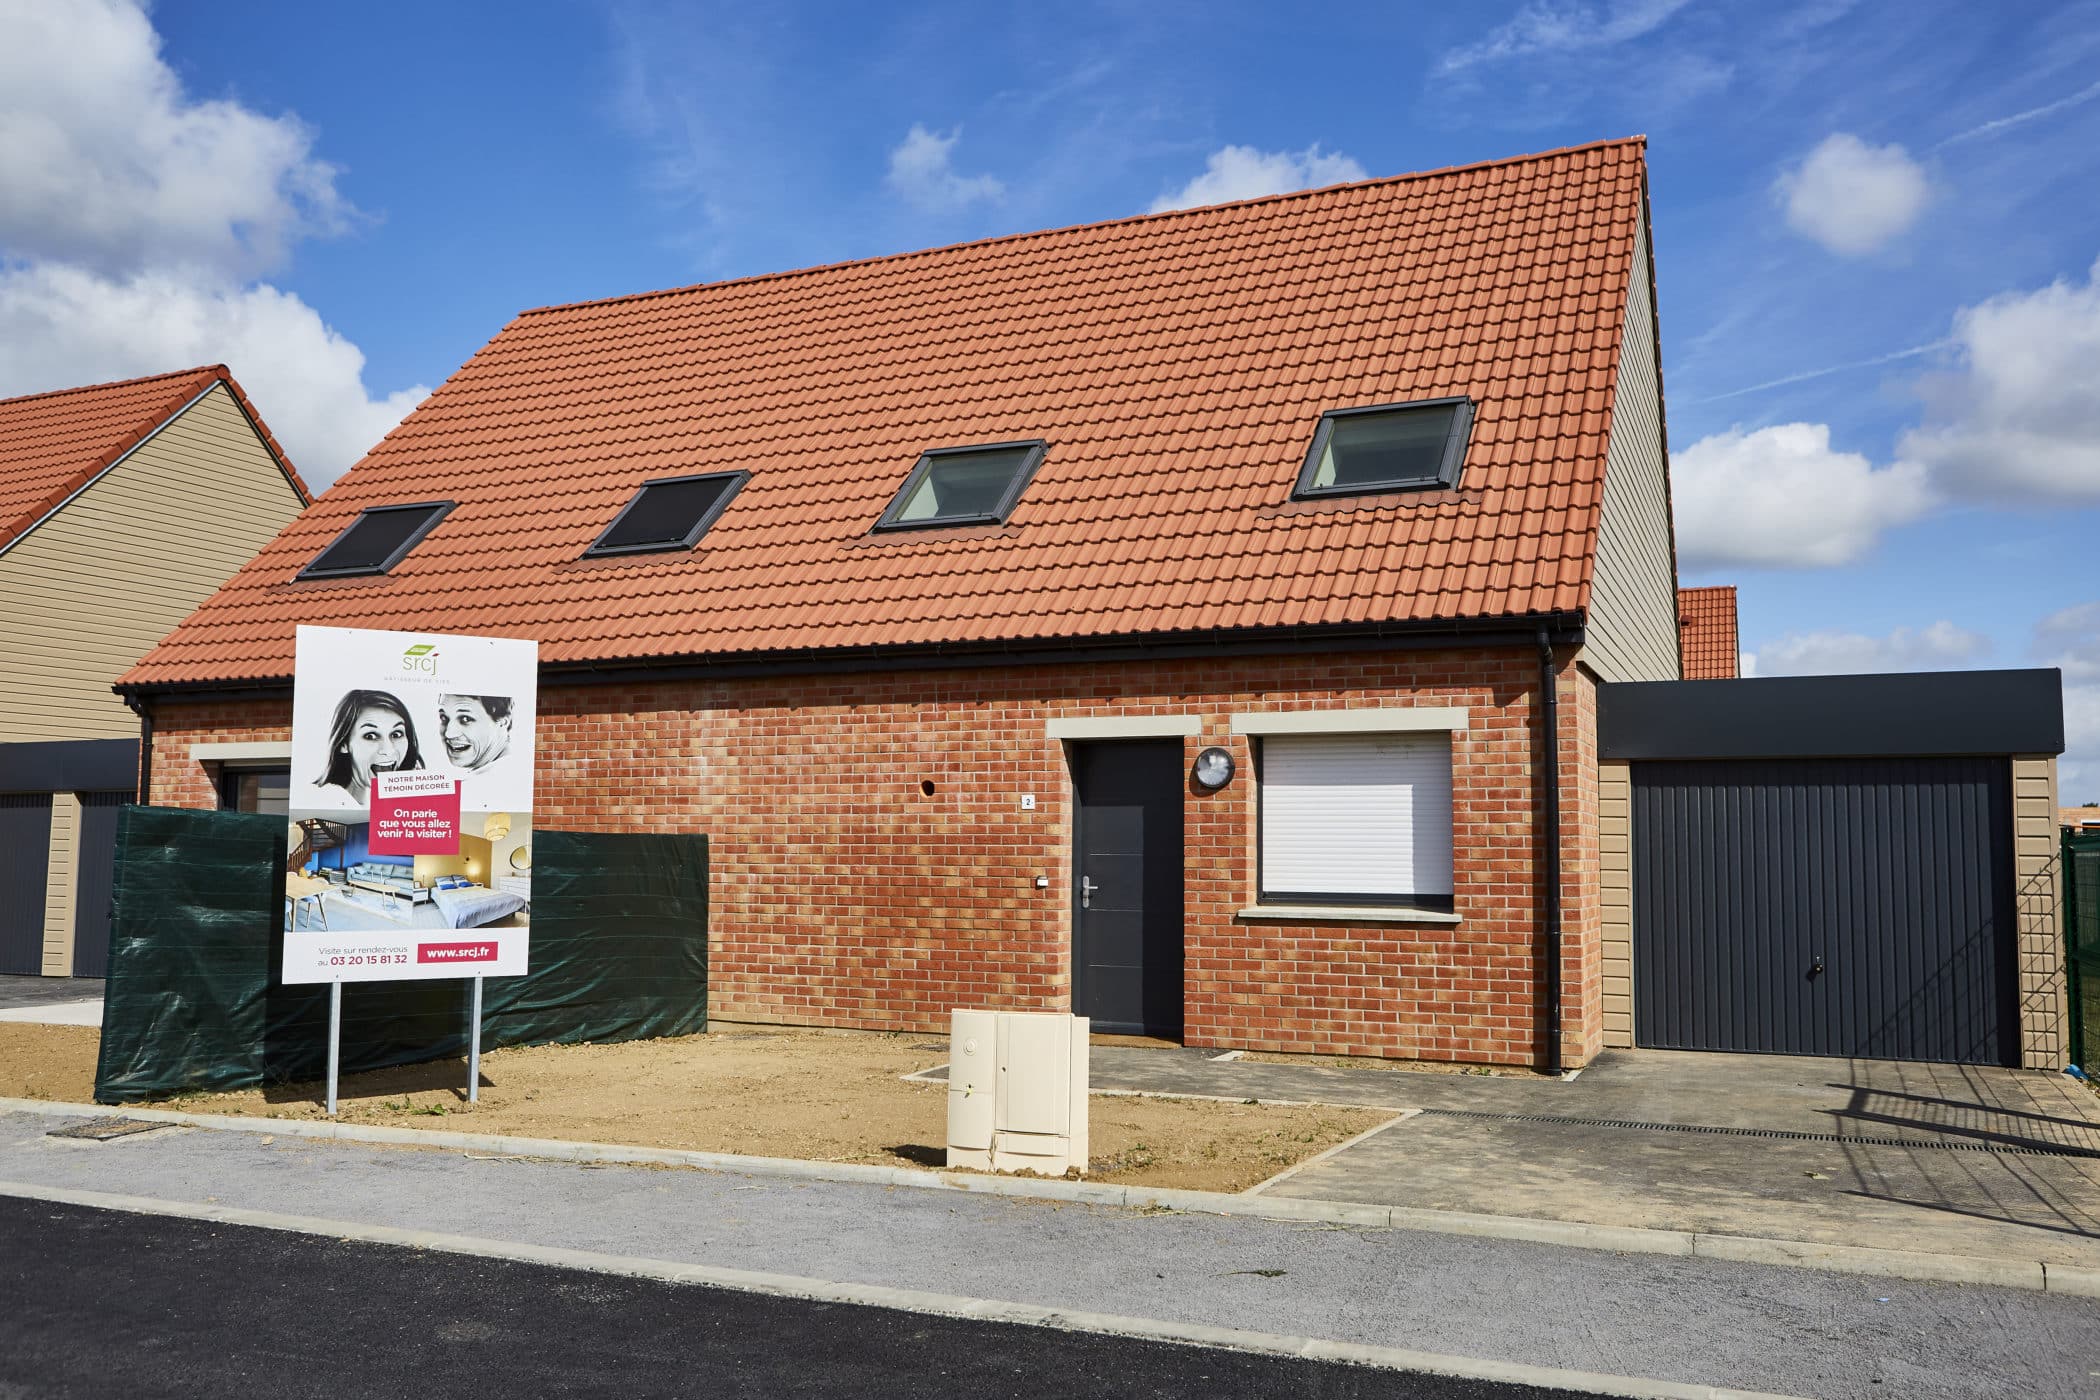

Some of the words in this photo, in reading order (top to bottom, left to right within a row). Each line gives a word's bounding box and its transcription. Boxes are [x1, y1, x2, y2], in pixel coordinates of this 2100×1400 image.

[402, 653, 439, 675] srcj
[415, 774, 445, 782] MAISON
[1026, 798, 1031, 806] 2
[393, 808, 410, 818] On
[411, 809, 438, 820] parie
[379, 820, 400, 830] que
[401, 820, 426, 828] vous
[427, 819, 451, 828] allez
[377, 828, 403, 838] venir
[405, 829, 414, 838] la
[416, 829, 447, 838] visiter
[318, 947, 341, 955] Visite
[358, 945, 408, 954] rendez-vous
[426, 946, 490, 959] www.srcj.fr
[330, 956, 346, 966] 03
[348, 956, 363, 965] 20
[366, 955, 378, 965] 15
[380, 955, 391, 964] 81
[394, 954, 408, 964] 32
